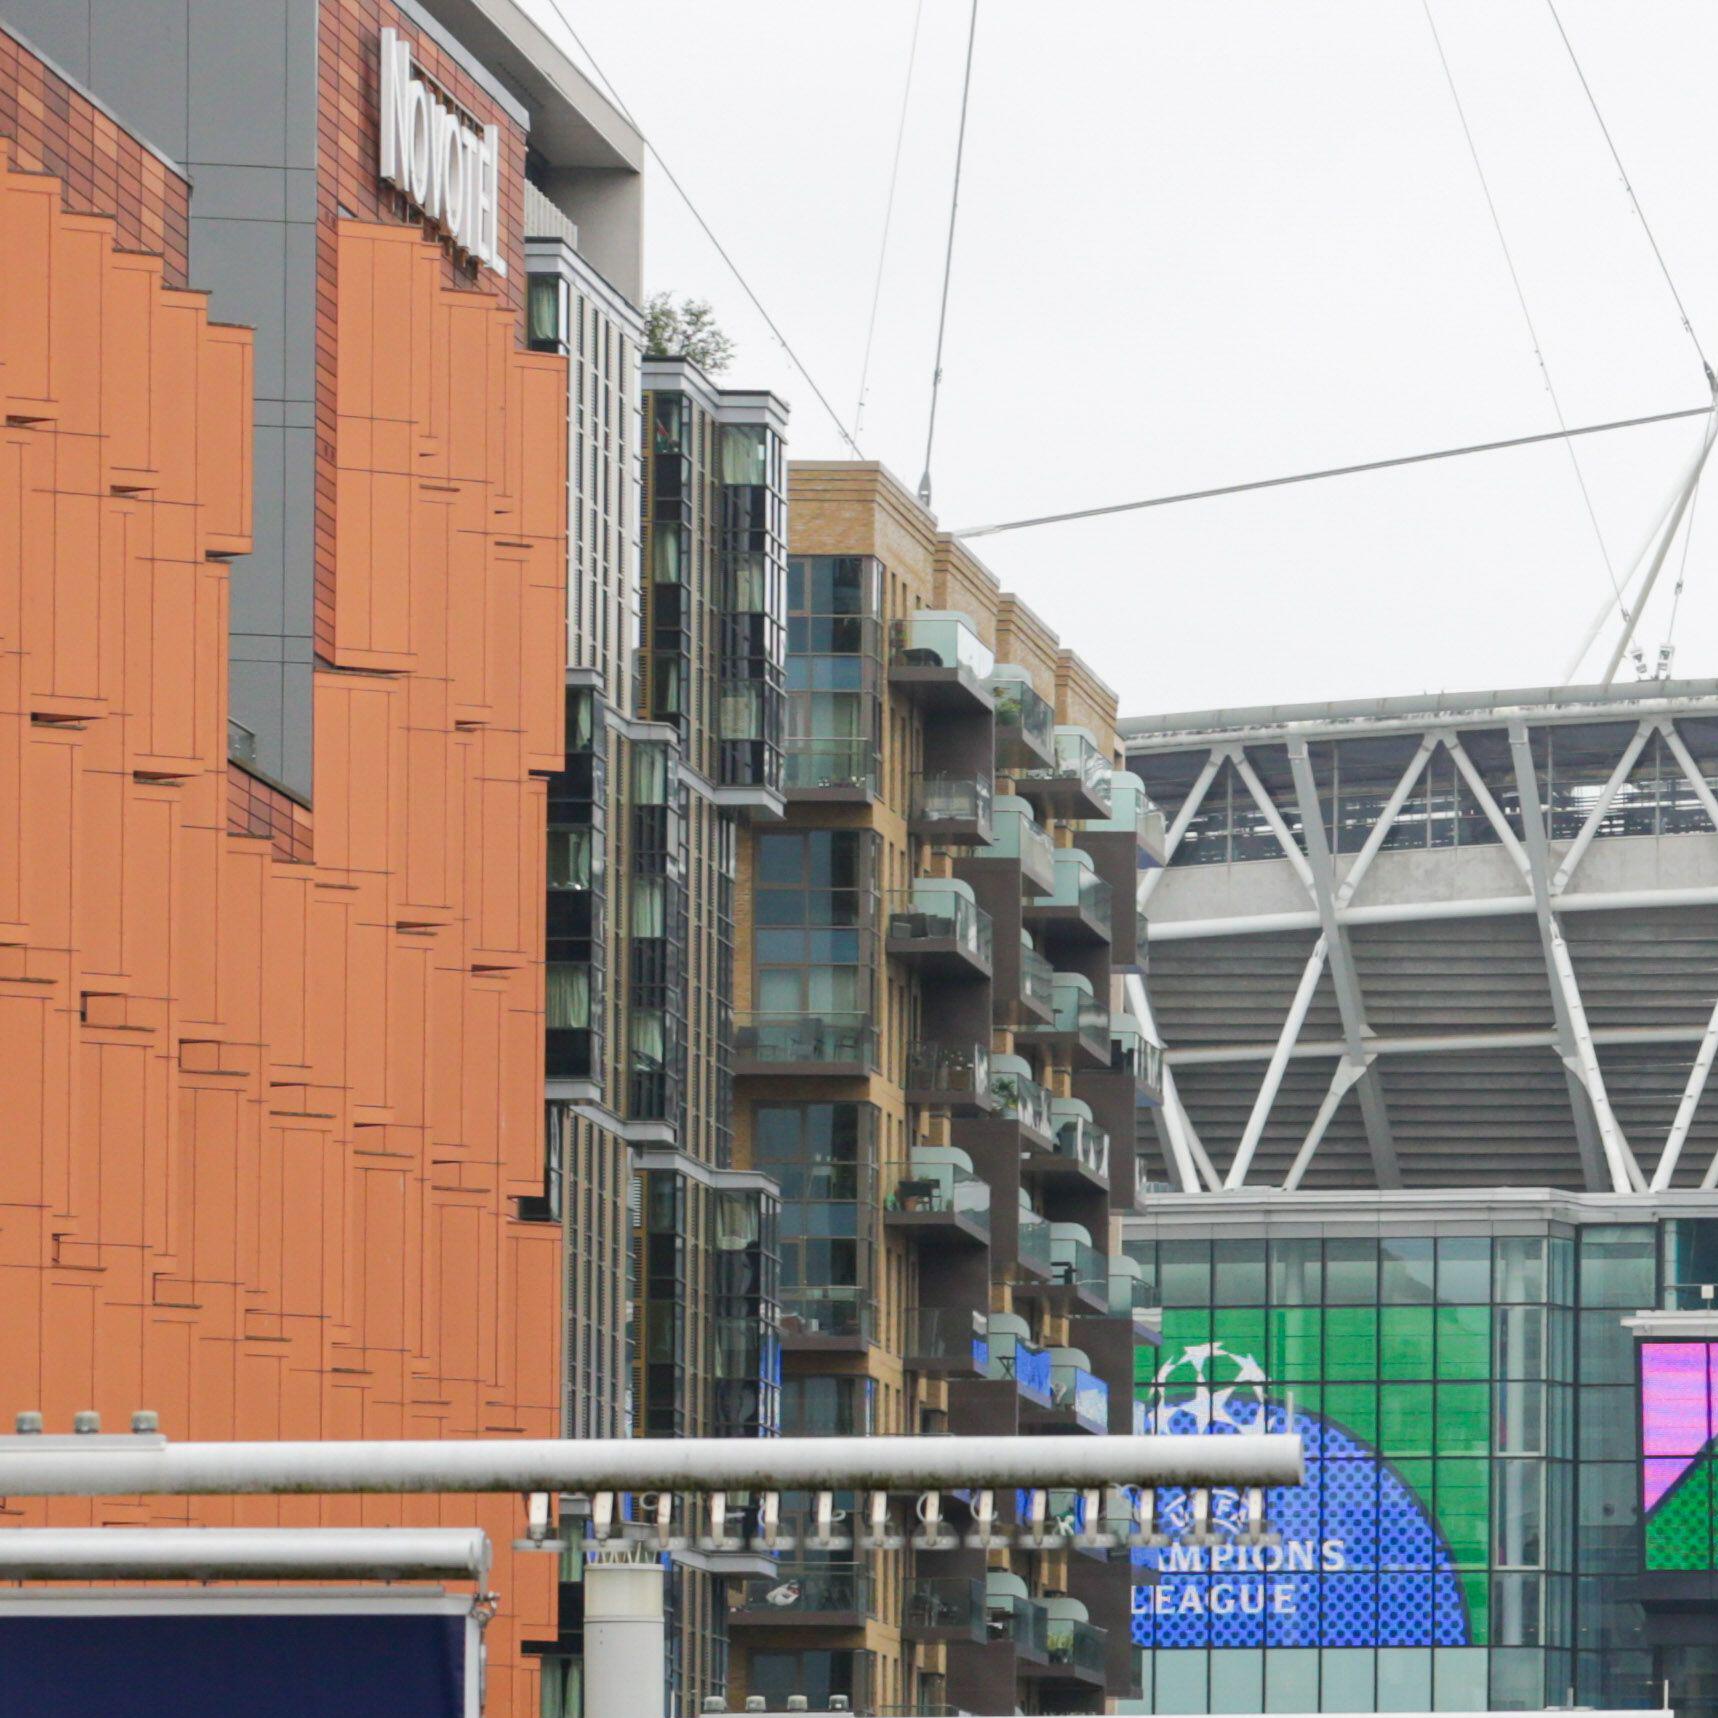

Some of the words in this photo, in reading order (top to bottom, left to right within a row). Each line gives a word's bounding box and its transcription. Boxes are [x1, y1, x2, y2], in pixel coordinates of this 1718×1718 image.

[380, 27, 507, 277] NOVOTEL
[1158, 1539, 1346, 1572] MPIONS
[1131, 1583, 1296, 1614] LEAGUE
